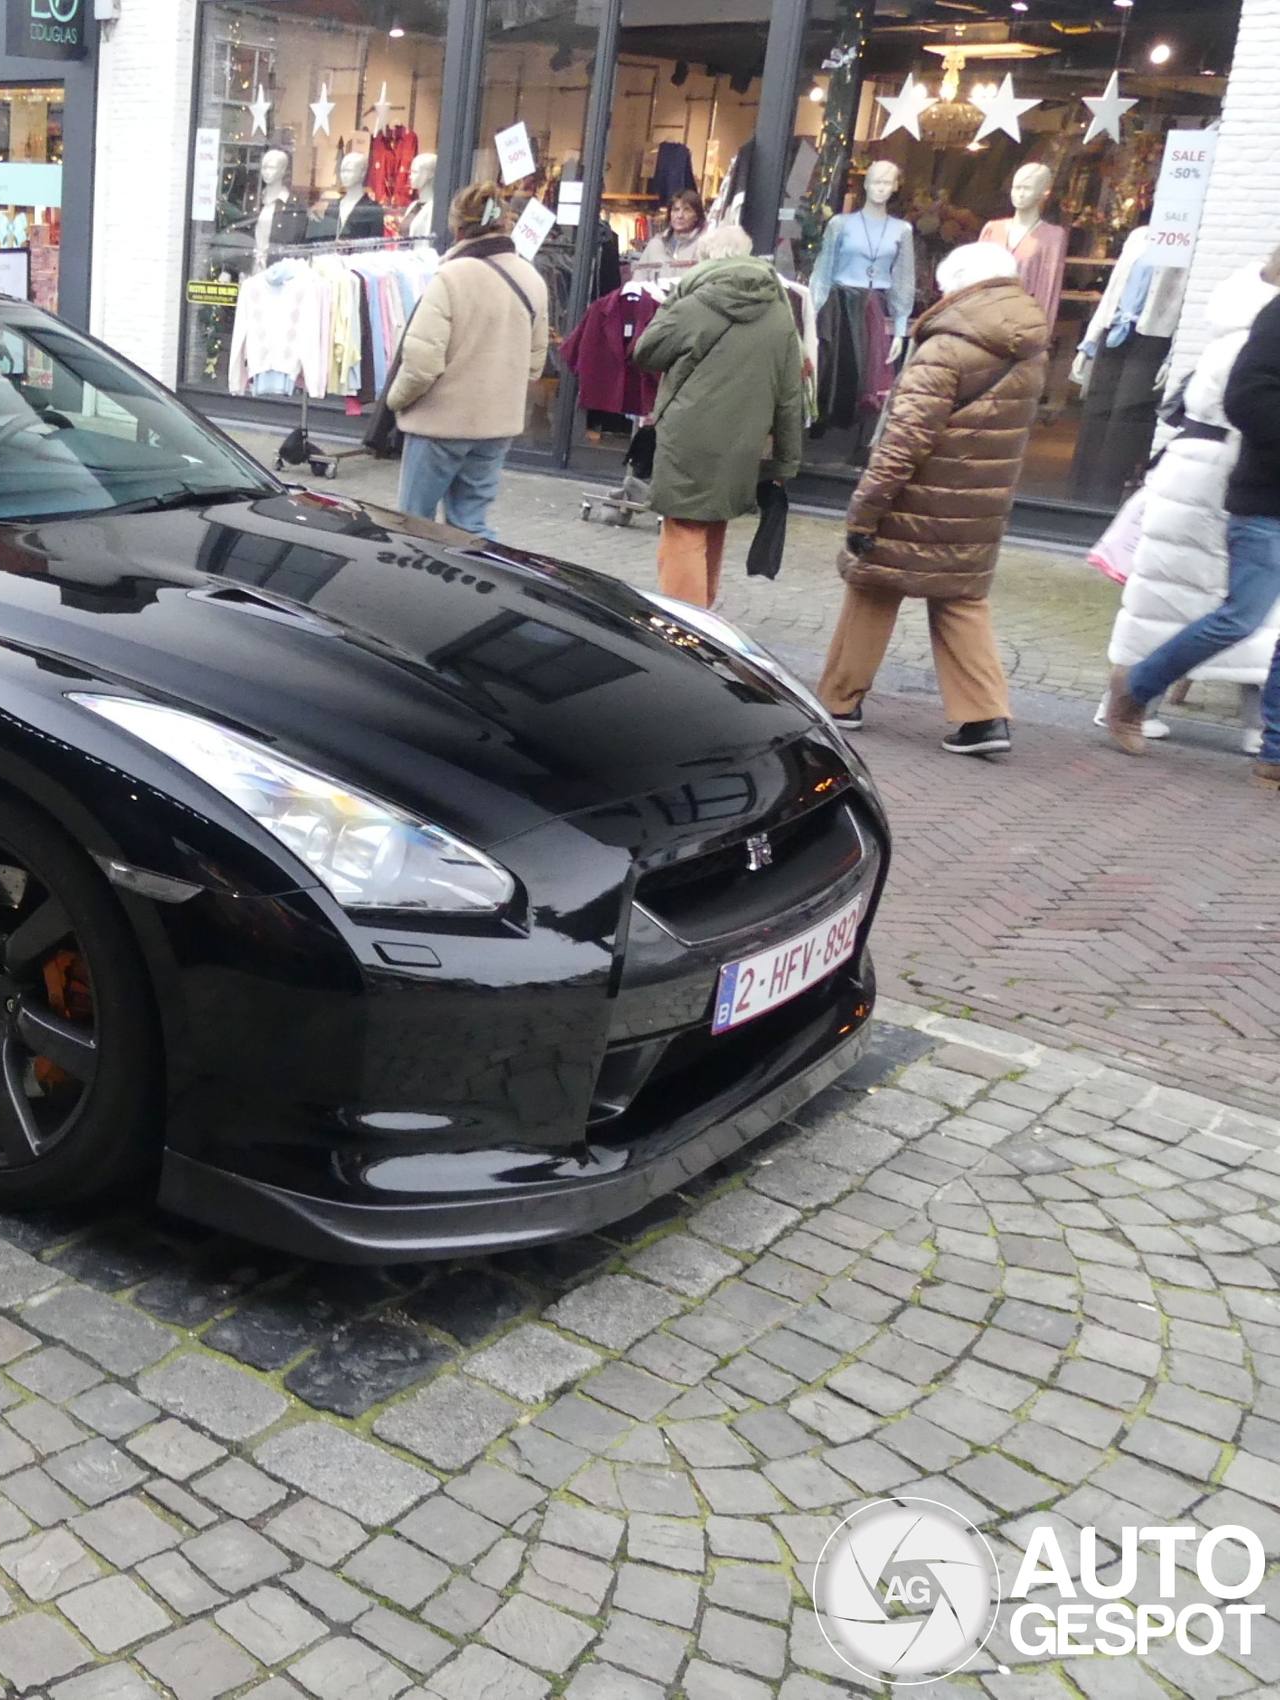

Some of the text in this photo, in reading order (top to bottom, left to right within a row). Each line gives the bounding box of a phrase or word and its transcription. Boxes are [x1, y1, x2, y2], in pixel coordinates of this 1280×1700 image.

[30, 23, 78, 44] DOUGLAS
[1171, 150, 1207, 162] SALE
[1169, 167, 1202, 179] -50%
[1164, 211, 1189, 222] SALE
[518, 223, 541, 245] -70%
[1150, 231, 1191, 247] -70%
[735, 909, 857, 1014] 2-HFV-892
[717, 1003, 730, 1025] B
